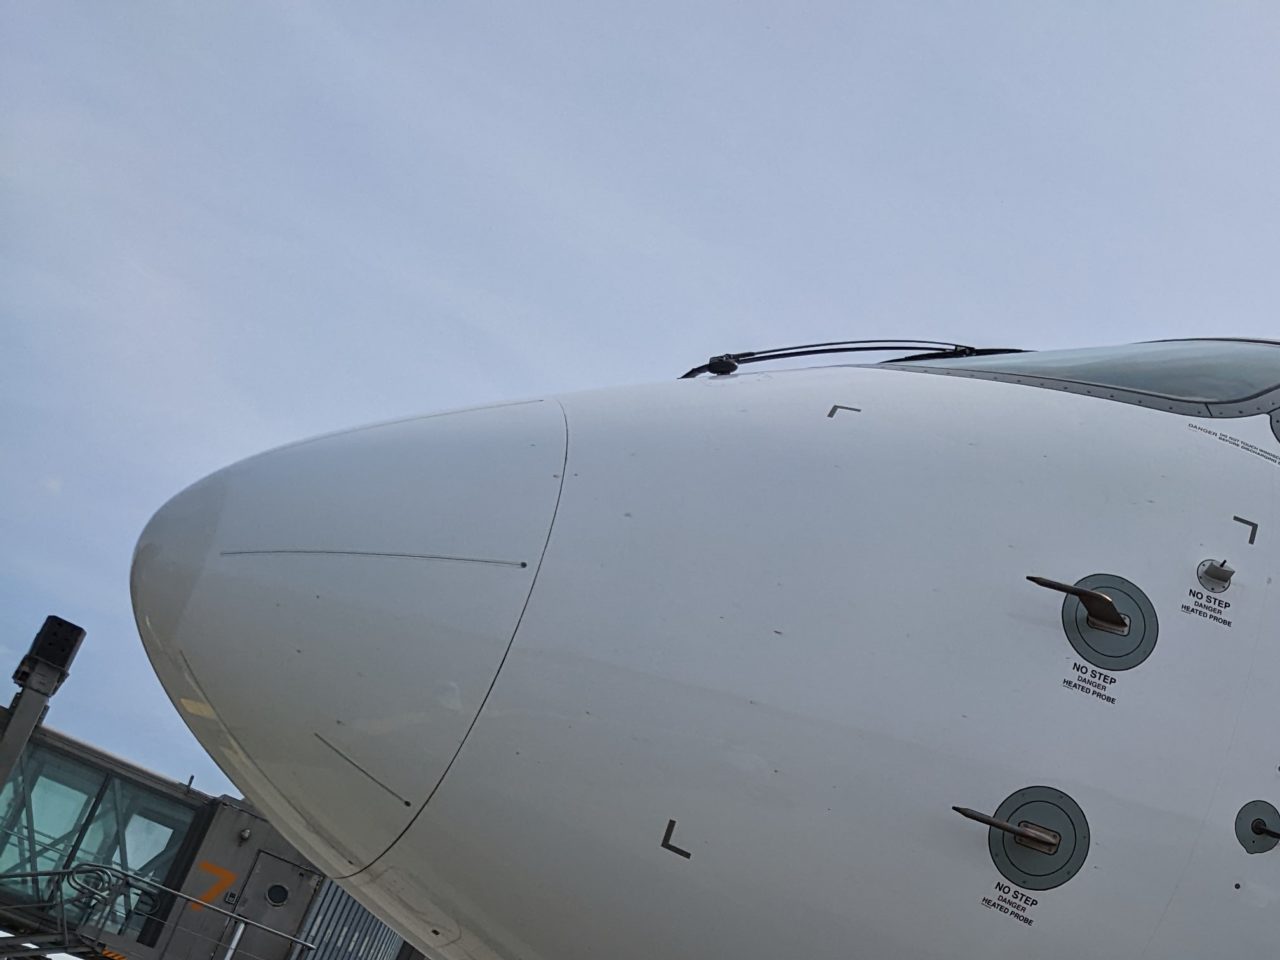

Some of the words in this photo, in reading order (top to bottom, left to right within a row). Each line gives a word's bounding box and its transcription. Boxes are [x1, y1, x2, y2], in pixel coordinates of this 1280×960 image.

[1188, 423, 1218, 437] DANGER
[1189, 589, 1203, 600] NO
[1205, 595, 1231, 609] STEP
[1194, 601, 1222, 615] DANGER
[1181, 604, 1208, 618] HEATED
[1209, 614, 1232, 627] PROBE
[1072, 662, 1088, 674] NO
[1090, 670, 1117, 685] STEP
[1077, 675, 1107, 691] DANGER
[1063, 678, 1091, 694] HEATED
[1092, 690, 1117, 704] PROBE
[995, 881, 1011, 894] NO
[1011, 890, 1038, 907] STEP
[997, 895, 1026, 913] DANGER
[982, 897, 1010, 914] HEATED
[1009, 911, 1034, 926] PROBE
